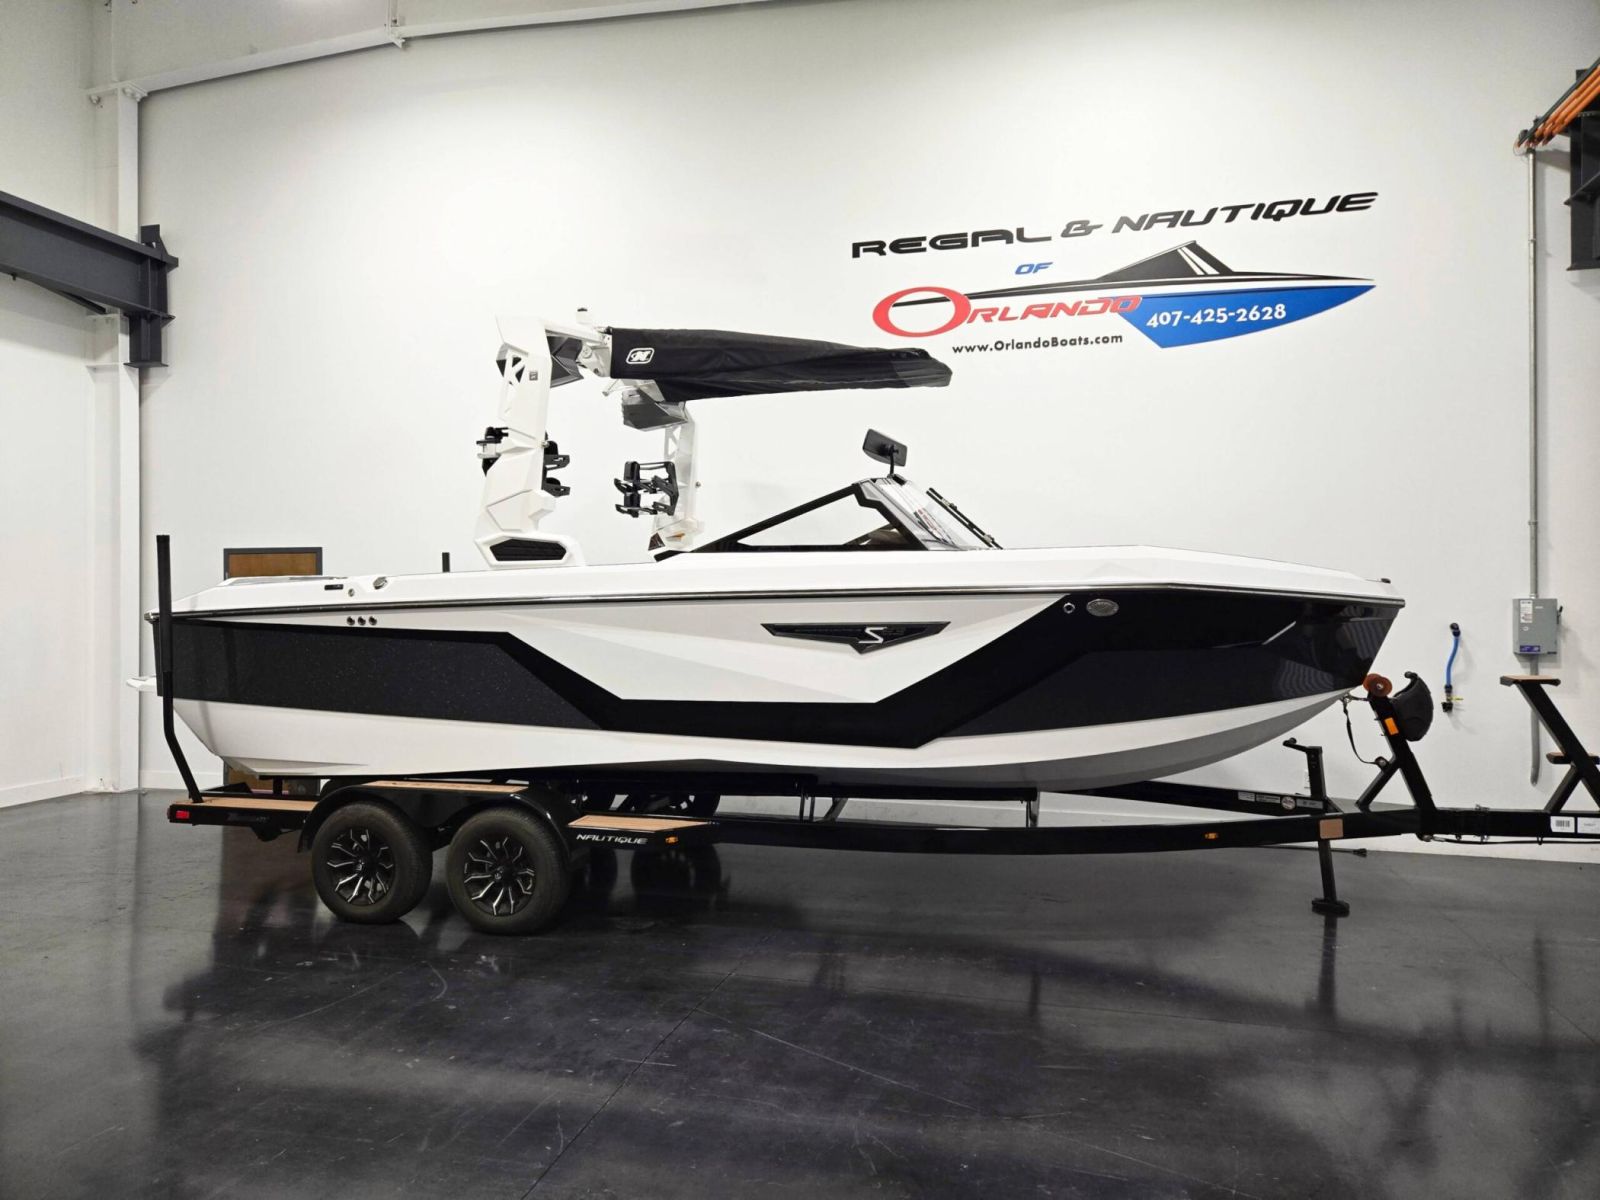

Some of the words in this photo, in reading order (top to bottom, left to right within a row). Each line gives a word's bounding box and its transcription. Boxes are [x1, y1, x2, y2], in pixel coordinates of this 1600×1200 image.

[852, 226, 1051, 258] REGAL
[1060, 219, 1103, 236] &
[1112, 192, 1379, 233] NAUTIQUE
[1015, 261, 1053, 275] OF
[872, 286, 1142, 338] ORLANDO
[1146, 303, 1287, 327] 407-425-2628
[952, 333, 1123, 353] www.OrlandoBoats.com
[576, 834, 648, 845] NAUTIQUE
